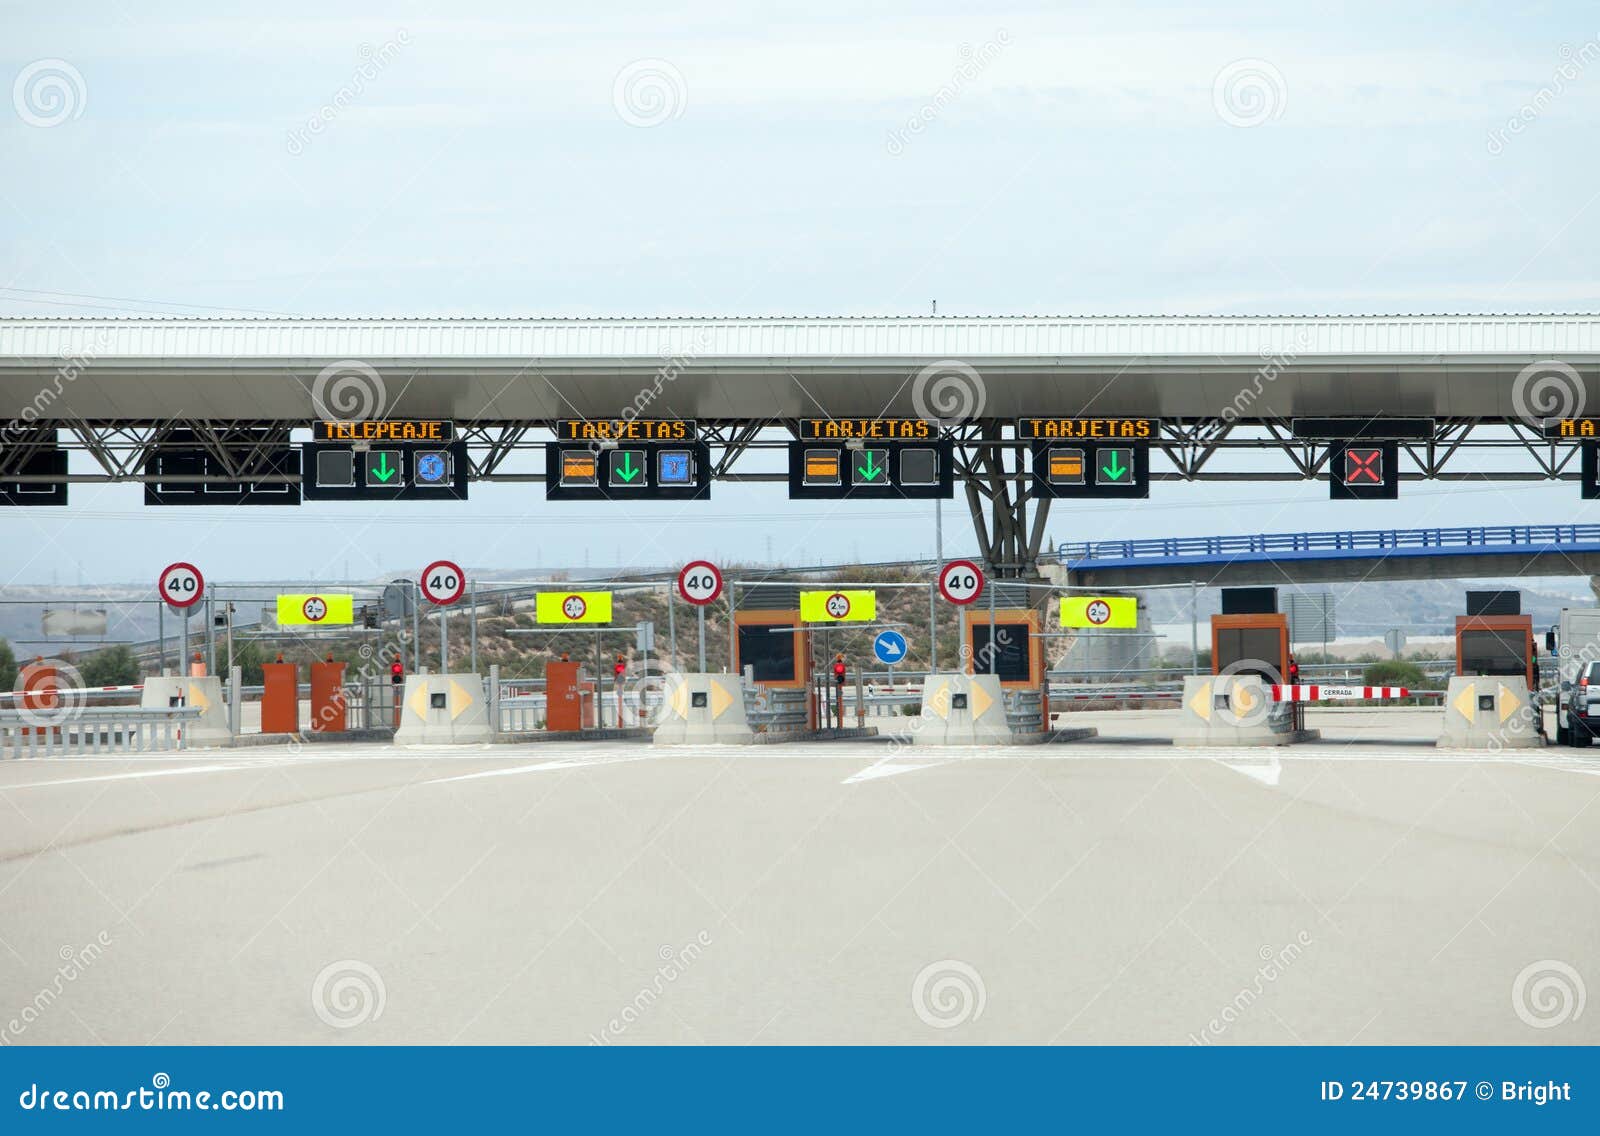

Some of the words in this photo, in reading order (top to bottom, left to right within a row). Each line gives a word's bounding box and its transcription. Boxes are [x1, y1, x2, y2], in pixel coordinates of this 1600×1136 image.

[323, 421, 442, 439] TELEPEAJE
[567, 421, 686, 439] TARJETAS
[811, 420, 930, 437] TARJETAS
[1030, 418, 1150, 437] TARJETAS
[168, 577, 196, 592] 40
[430, 575, 457, 590] 40
[688, 575, 715, 590] 40
[948, 575, 976, 590] 40
